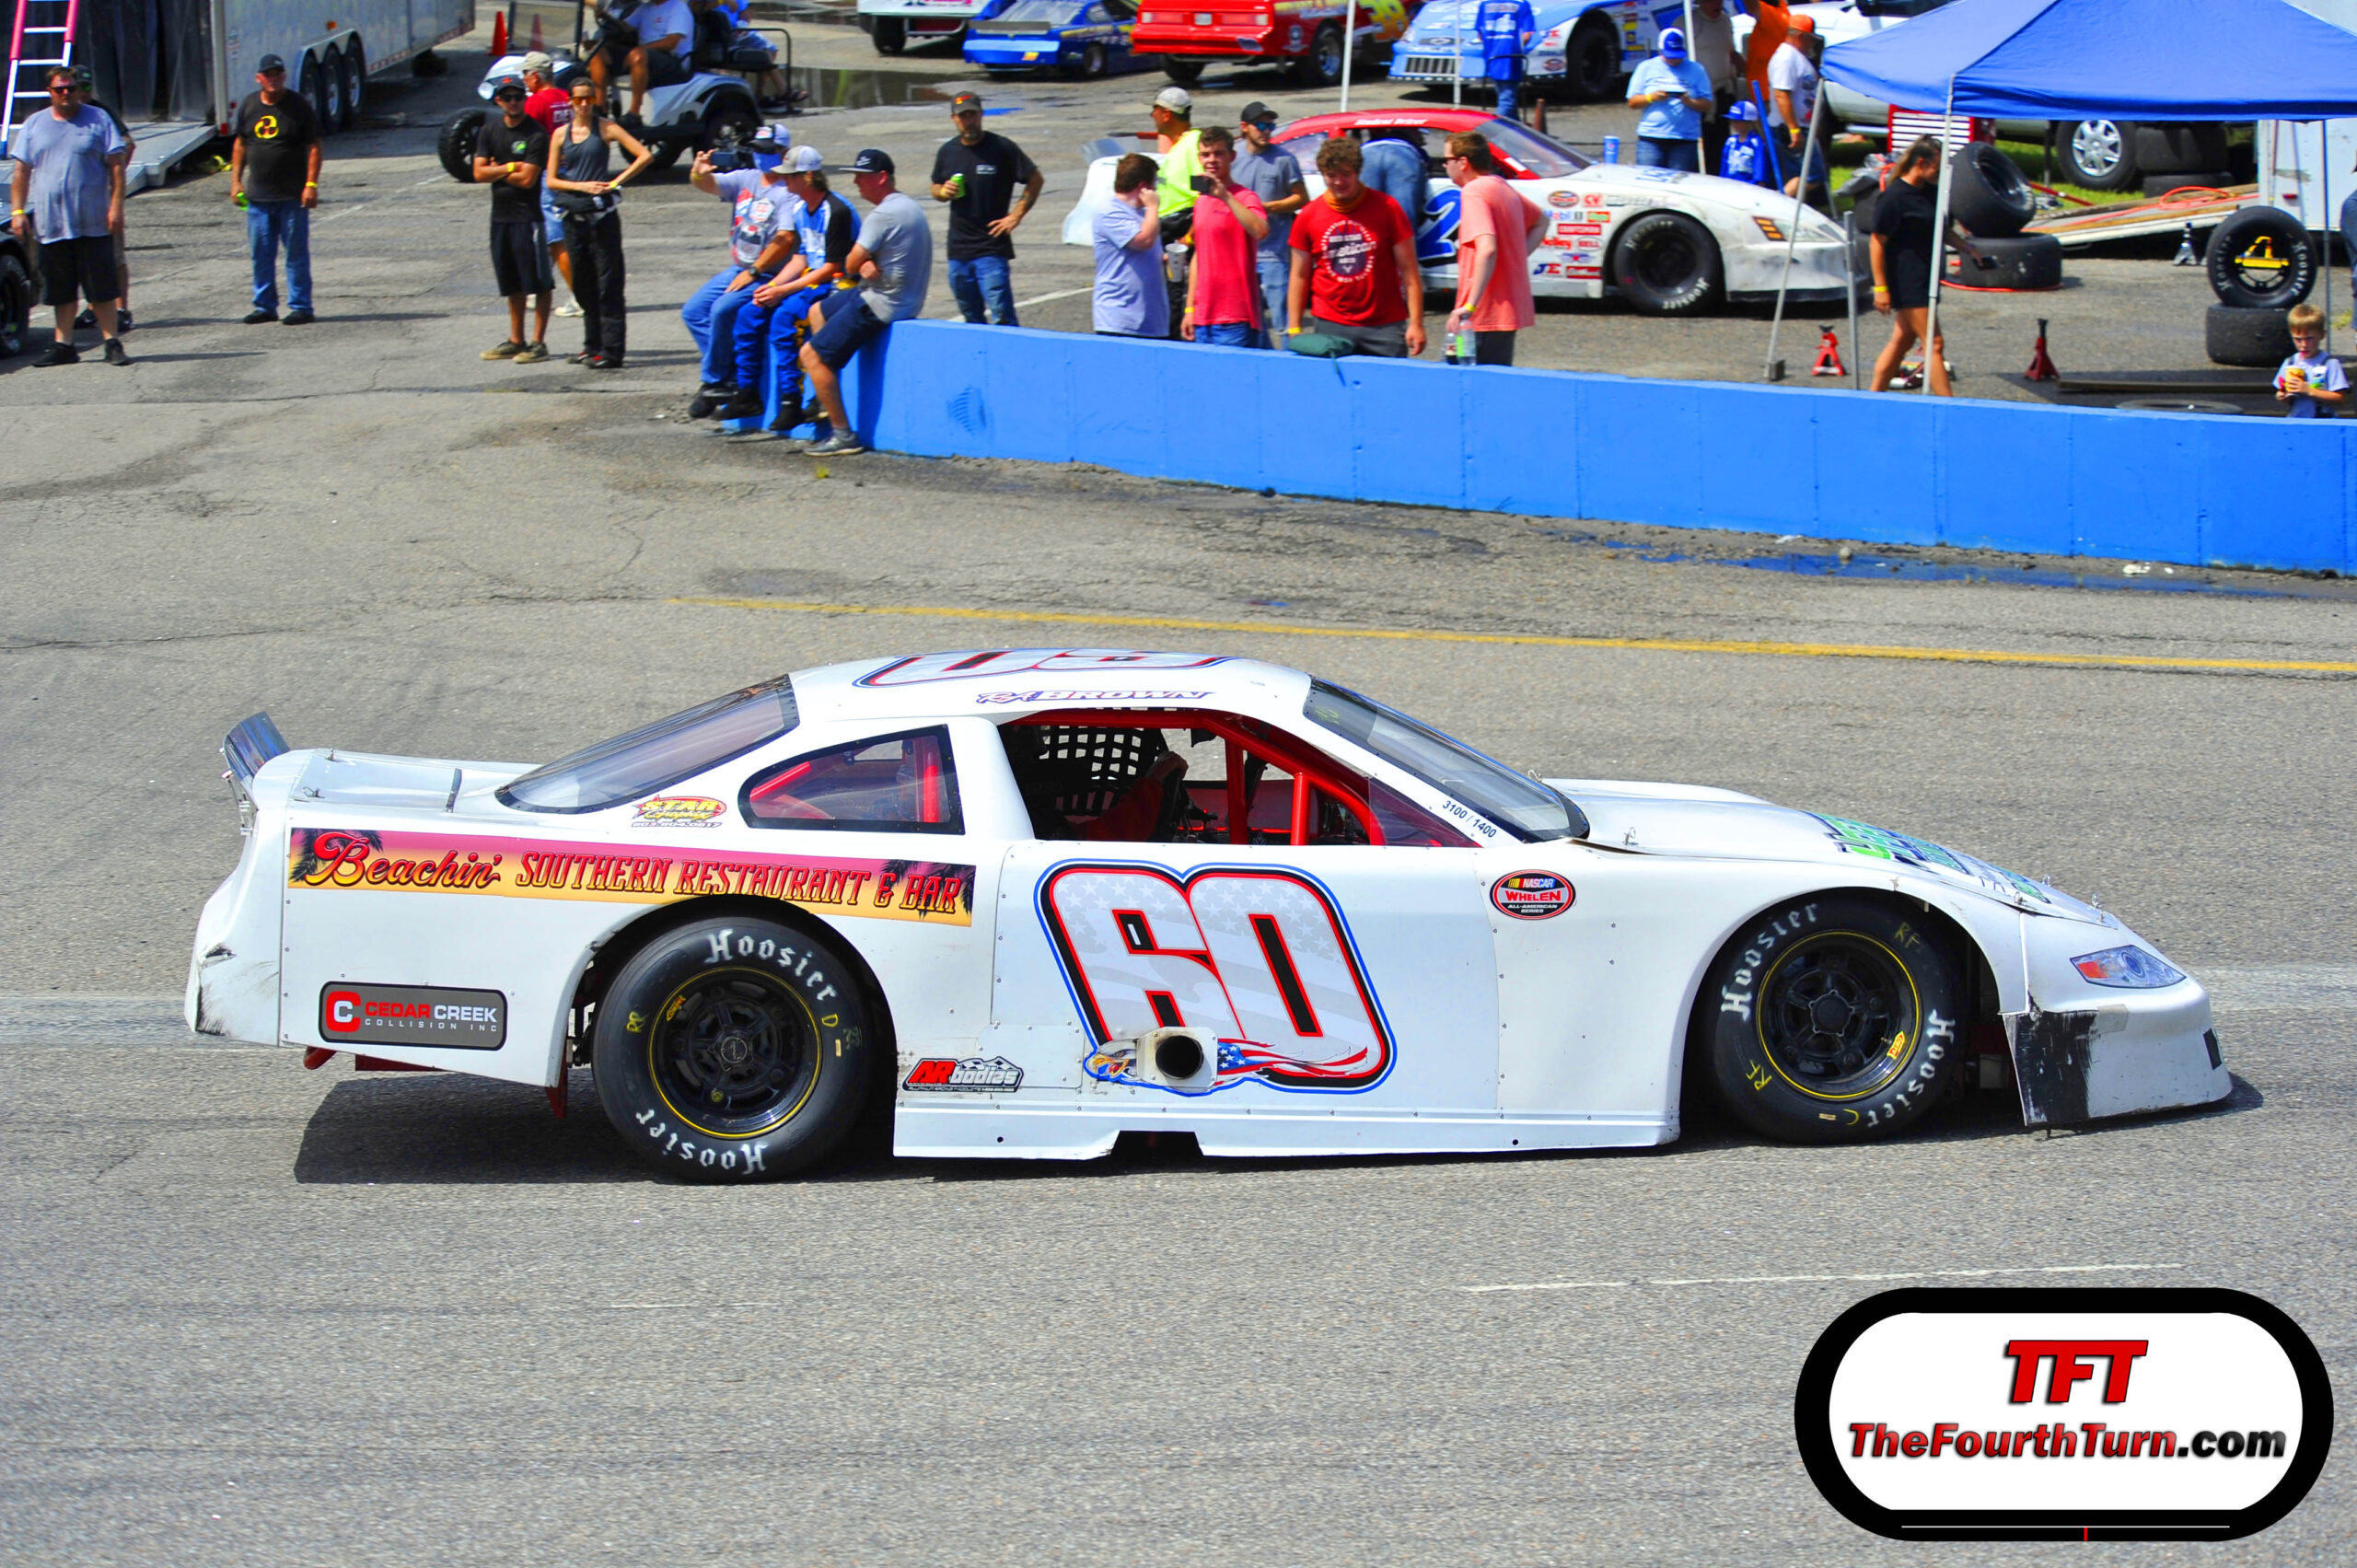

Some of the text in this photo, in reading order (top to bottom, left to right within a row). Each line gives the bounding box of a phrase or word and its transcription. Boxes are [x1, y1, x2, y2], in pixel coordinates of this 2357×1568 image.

[1032, 691, 1215, 702] BROWN
[641, 800, 720, 811] STAR
[1442, 800, 1468, 819] 3100
[1472, 818, 1497, 839] 1400
[515, 851, 674, 894] SOUTHERN
[672, 858, 872, 905] RESTAURANT
[873, 872, 898, 908] &
[899, 874, 963, 914] BAR
[1504, 889, 1562, 901] WHELEN
[1522, 877, 1556, 889] NASCAR
[703, 928, 839, 1001] Hoosier
[1034, 858, 1398, 1096] 60
[1720, 902, 1819, 1021] Hoosier
[365, 1002, 497, 1023] CEDAR CREEK
[365, 1018, 497, 1032] COLLISION INC
[1867, 1009, 1956, 1128] Hoosier
[635, 1109, 769, 1175] Hoosier
